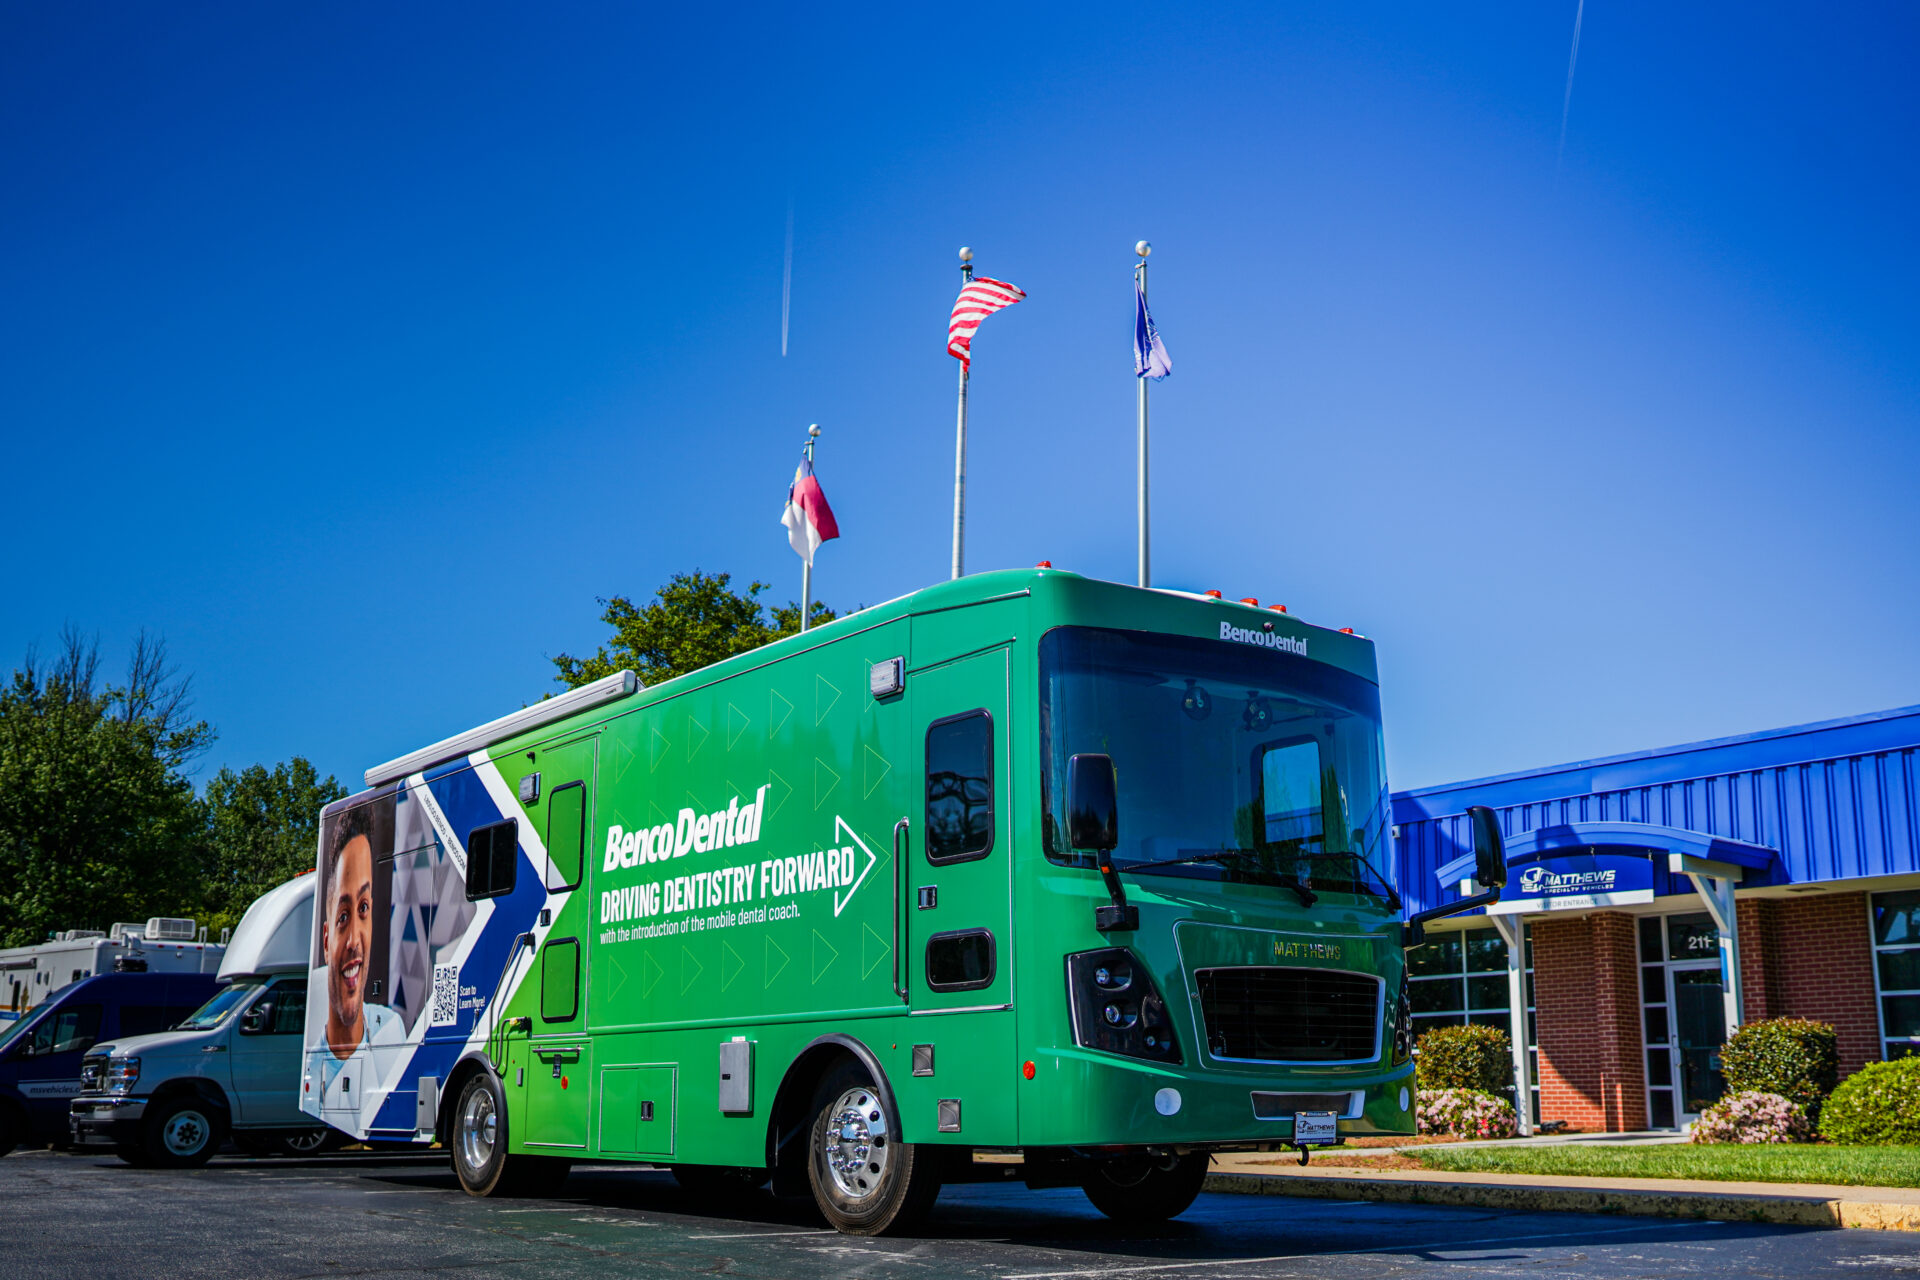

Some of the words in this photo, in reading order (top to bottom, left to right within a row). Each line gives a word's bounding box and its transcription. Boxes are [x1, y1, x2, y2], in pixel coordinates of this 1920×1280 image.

[603, 784, 766, 872] BencoDental
[601, 882, 659, 924] DRIVING
[663, 864, 755, 914] DENTISTRY
[760, 846, 854, 898] FORWARD
[1545, 870, 1616, 886] MATTHEWS
[600, 928, 616, 945] with
[618, 926, 629, 942] the
[631, 920, 679, 941] introduction
[680, 915, 690, 933] of
[691, 913, 705, 931] the
[707, 909, 736, 929] mobile
[738, 905, 767, 926] dental
[768, 900, 800, 920] coach.
[1274, 941, 1341, 960] MATTHEWS
[1688, 935, 1710, 950] 211
[459, 985, 471, 996] Scan
[471, 985, 476, 995] to
[459, 998, 472, 1009] Learn
